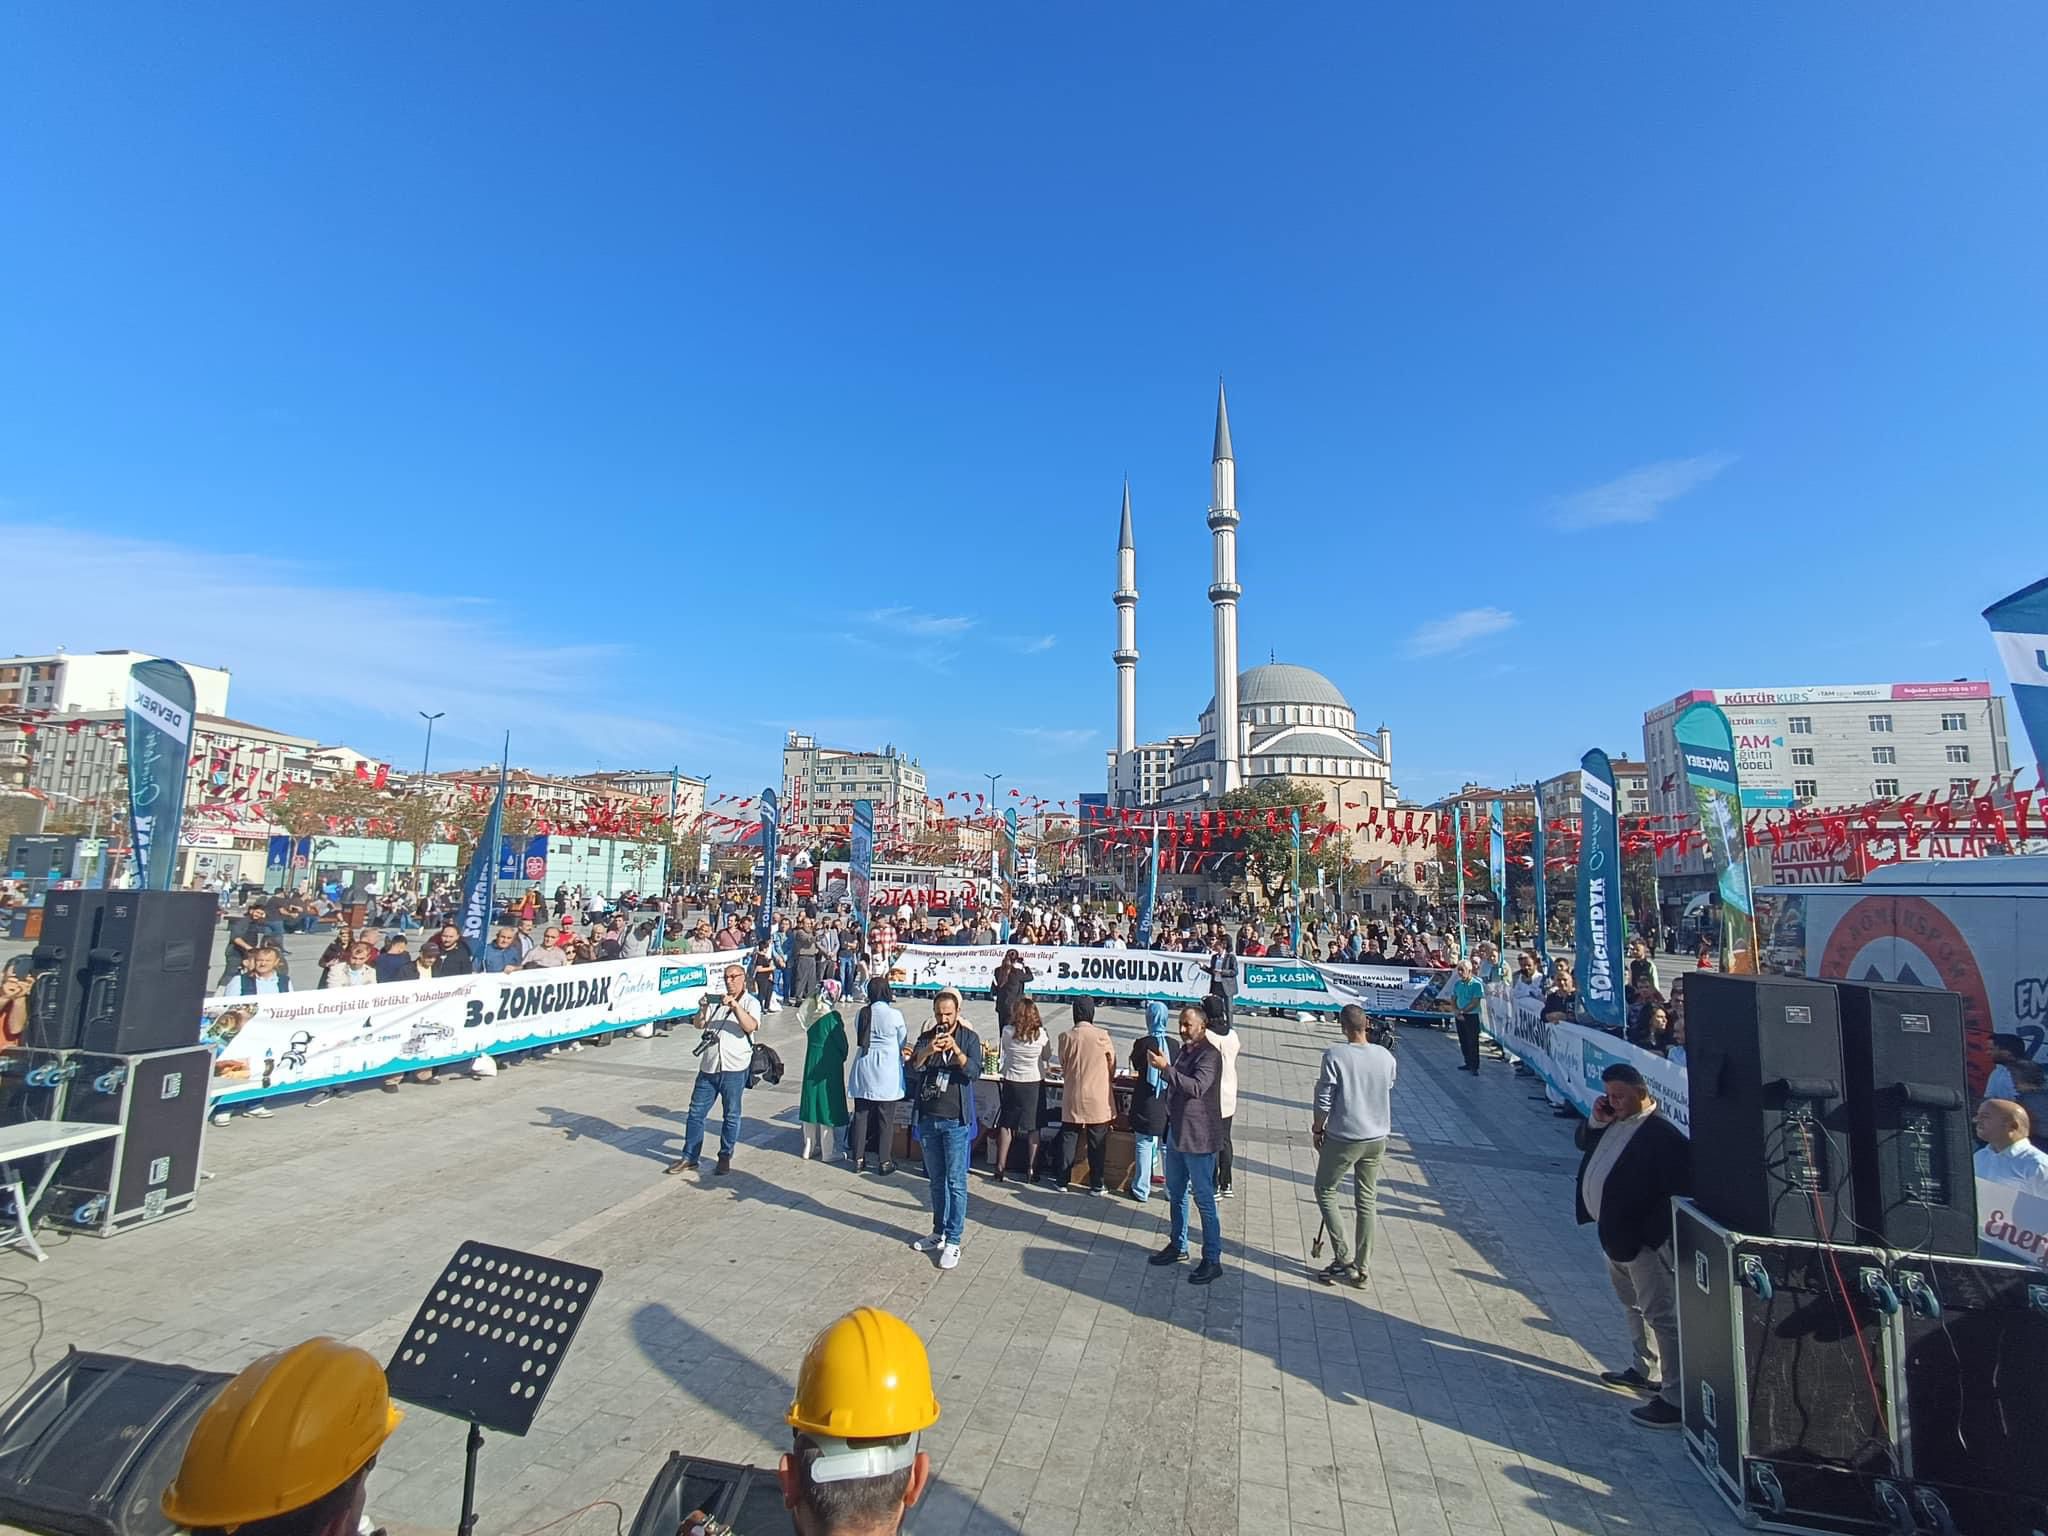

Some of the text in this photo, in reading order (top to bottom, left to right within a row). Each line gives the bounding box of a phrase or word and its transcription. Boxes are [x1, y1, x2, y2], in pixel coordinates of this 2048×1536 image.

[1736, 750, 1771, 761] ğitim
[1929, 837, 2015, 858] ALA
[1775, 865, 1848, 884] EDAVA
[1081, 958, 1184, 983] ZONGULDAK
[1249, 973, 1316, 983] 09-12 KASIM
[1374, 983, 1404, 991] ALANI
[317, 1000, 356, 1015] Enerjisi
[357, 999, 370, 1010] ile
[372, 994, 410, 1008] Birlikte
[464, 1000, 494, 1028] 3.
[496, 976, 613, 1020] ZONGULDAK
[1586, 1063, 1605, 1080] 09-1
